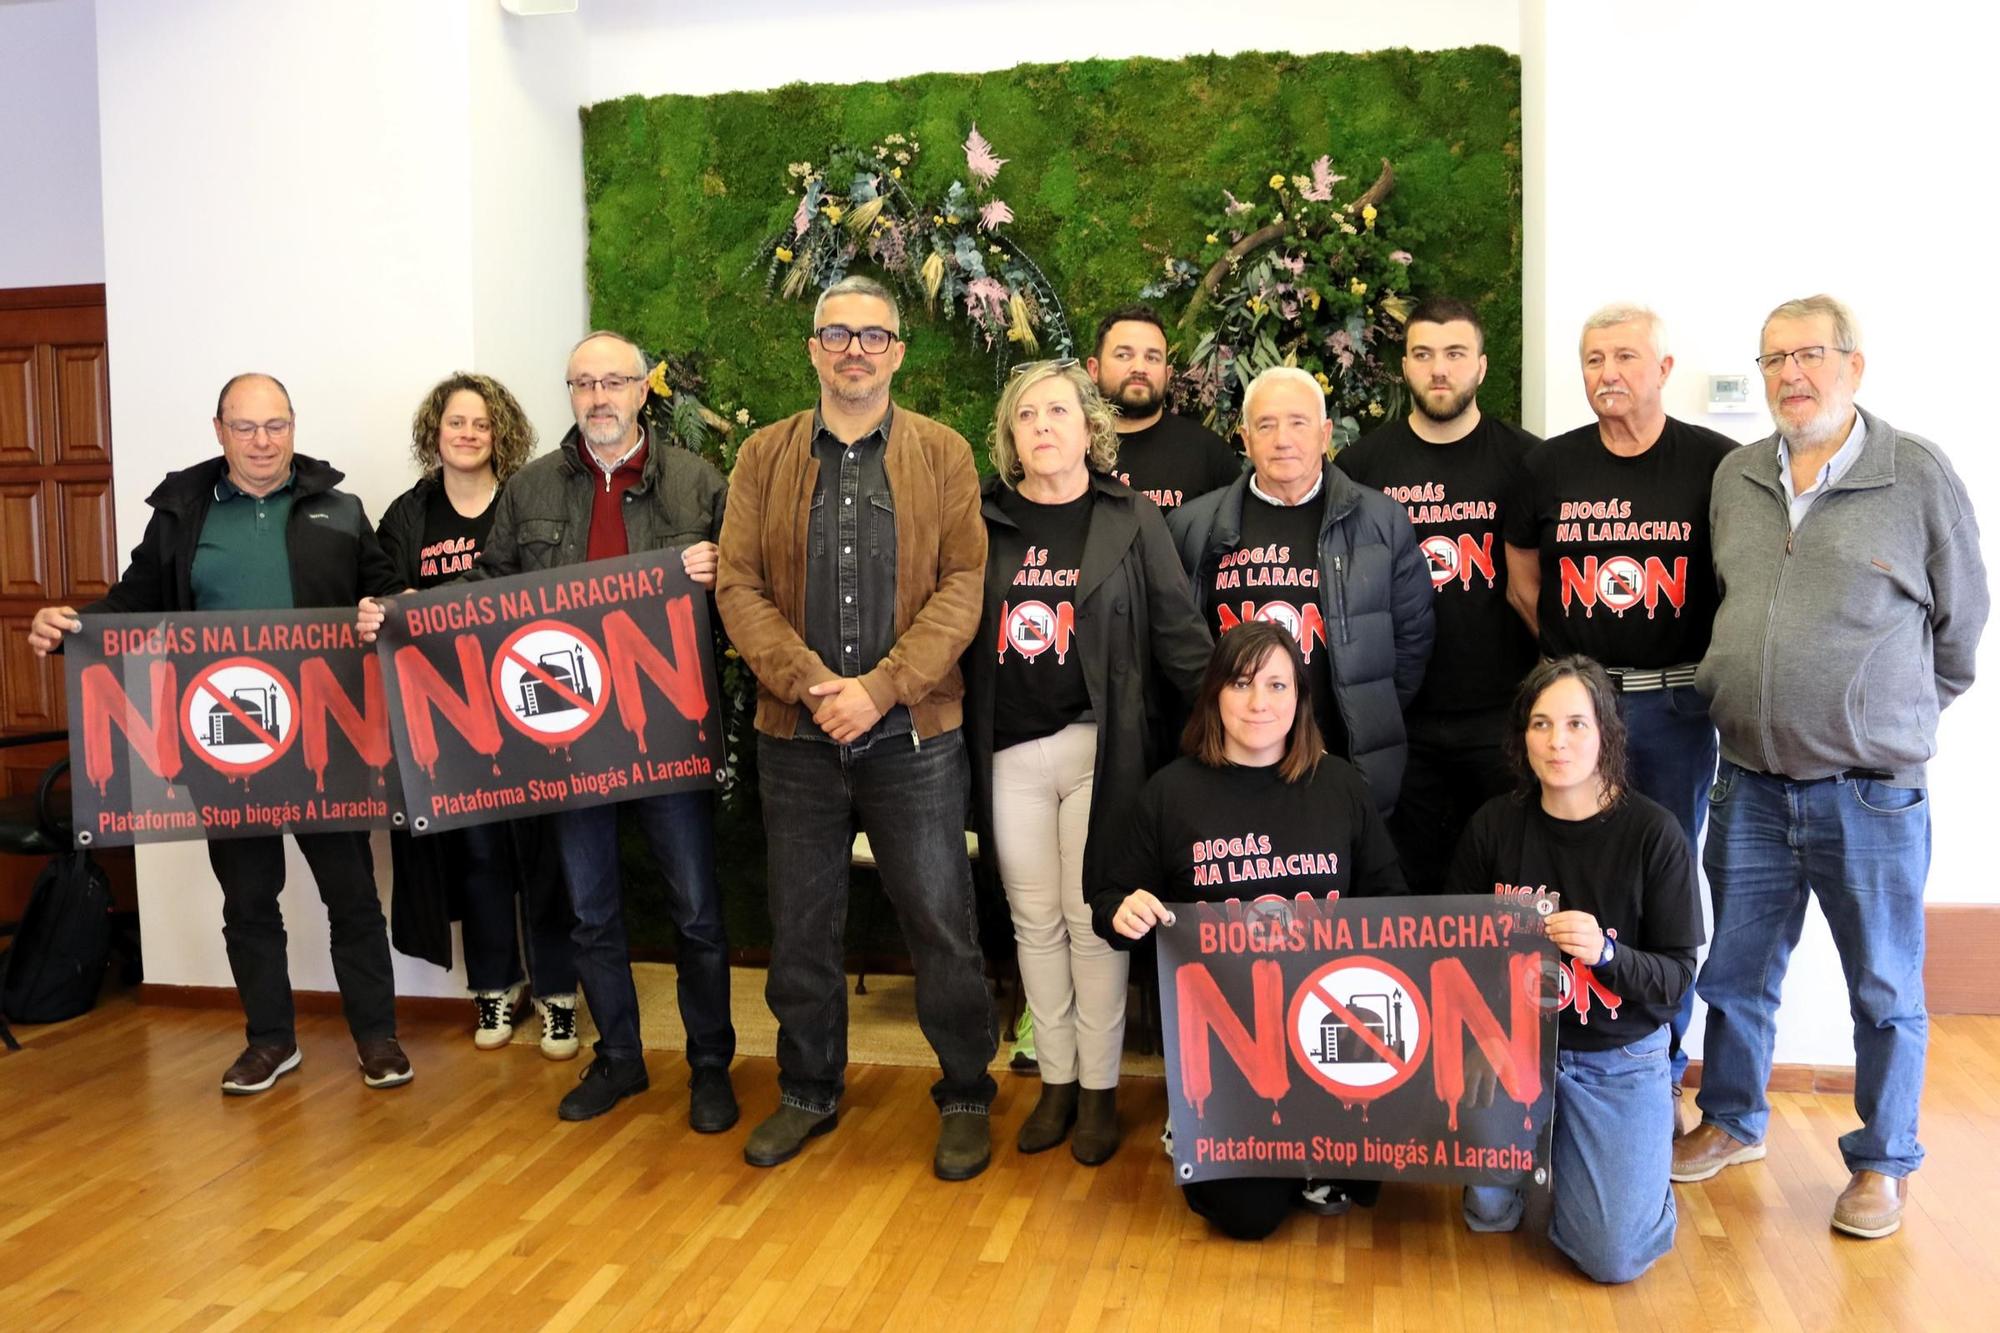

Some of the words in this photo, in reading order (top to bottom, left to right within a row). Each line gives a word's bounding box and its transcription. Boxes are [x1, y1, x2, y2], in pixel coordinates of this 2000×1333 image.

[1408, 501, 1497, 524] LARACHA?
[1560, 498, 1632, 520] BIOGÁS
[1556, 523, 1582, 542] NA
[1588, 521, 1691, 541] LARACHA?
[421, 559, 438, 577] NA
[1219, 544, 1290, 569] BIOGÁS
[1013, 569, 1080, 587] ARACH
[1215, 570, 1241, 590] NA
[1246, 567, 1319, 588] LARAC
[1558, 555, 1688, 619] NON
[406, 594, 496, 638] BIOGÁS
[500, 590, 536, 621] NA
[540, 567, 665, 614] LARACHA?
[104, 622, 196, 656] BIOGÁS
[203, 626, 234, 652] NA
[394, 594, 709, 783] NON
[81, 652, 392, 799] NON
[431, 785, 526, 818] Plataforma
[528, 776, 568, 802] Stop
[571, 766, 628, 796] biogás
[632, 767, 645, 784] A
[649, 754, 711, 780] Laracha
[99, 809, 196, 833] Plataforma
[202, 805, 241, 829] Stop
[246, 801, 301, 827] biogás
[306, 800, 317, 820] A
[322, 797, 387, 819] Laracha
[1193, 833, 1272, 862] BIOGÁS
[1194, 864, 1223, 886] NA
[1228, 853, 1338, 882] LARACHA?
[1200, 912, 1306, 954] BIOGÁS
[1313, 917, 1354, 950] NA
[1360, 914, 1513, 950] LARACHA?
[1175, 951, 1543, 1132] NON
[1195, 1137, 1306, 1164] Plataforma
[1312, 1136, 1357, 1169] Stop
[1364, 1136, 1429, 1172] biogás
[1434, 1140, 1448, 1165] A
[1454, 1140, 1533, 1171] Laracha
